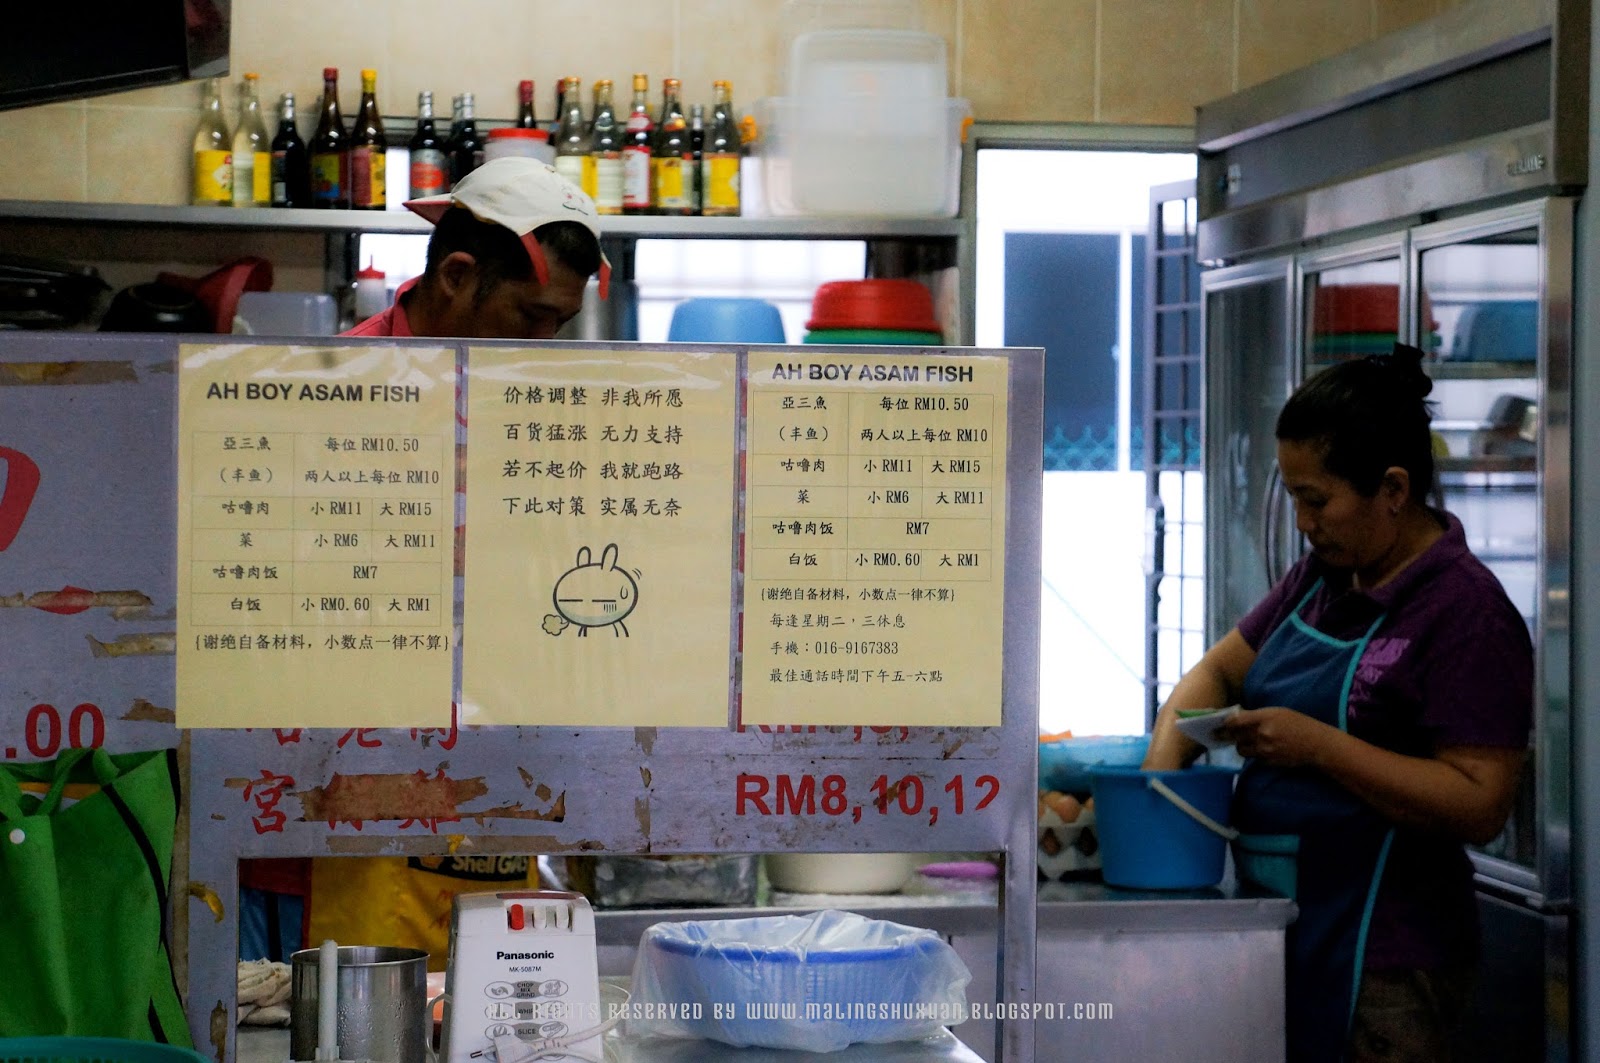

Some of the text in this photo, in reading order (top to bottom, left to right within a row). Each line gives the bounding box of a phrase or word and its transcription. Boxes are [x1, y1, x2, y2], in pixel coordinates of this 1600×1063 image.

[773, 363, 973, 382] AH BOY ASAM FISH
[207, 382, 419, 402] AH BOY ASAM FISH
[504, 386, 683, 407] 价格调整 非我所愿
[782, 396, 968, 411] 亞三魚 每位 RM10.50
[504, 422, 683, 444] 百货猛涨 无力支持
[861, 428, 952, 442] 两人以上每位
[957, 429, 987, 442] RM10
[223, 436, 418, 452] 亞三魚 每位 RM10.50
[502, 459, 683, 480] 若不起价 我就跑路
[864, 460, 877, 473] 小
[882, 459, 912, 472] RM11
[931, 460, 945, 473] 大
[950, 460, 980, 473] RM15
[305, 469, 401, 484] 两人以上每位
[407, 471, 439, 483] RM10
[798, 489, 983, 504] 菜 小 RM6 大 RM11
[311, 502, 324, 515] 小
[330, 501, 361, 515] RM11
[380, 503, 394, 515] 大
[400, 502, 431, 515] RM15
[503, 496, 682, 517] 下此对策 实属无奈
[906, 522, 929, 535] RM7
[240, 532, 434, 547] 菜 小 RM6 大 RM11
[789, 553, 978, 567] 白饭 小 RM0.60 大 RM1
[353, 566, 377, 579] RM7
[231, 598, 429, 611] 白饭 小 RM0.60 大 RM1
[452, 856, 495, 873] Shell
[497, 950, 554, 960] Panasonic
